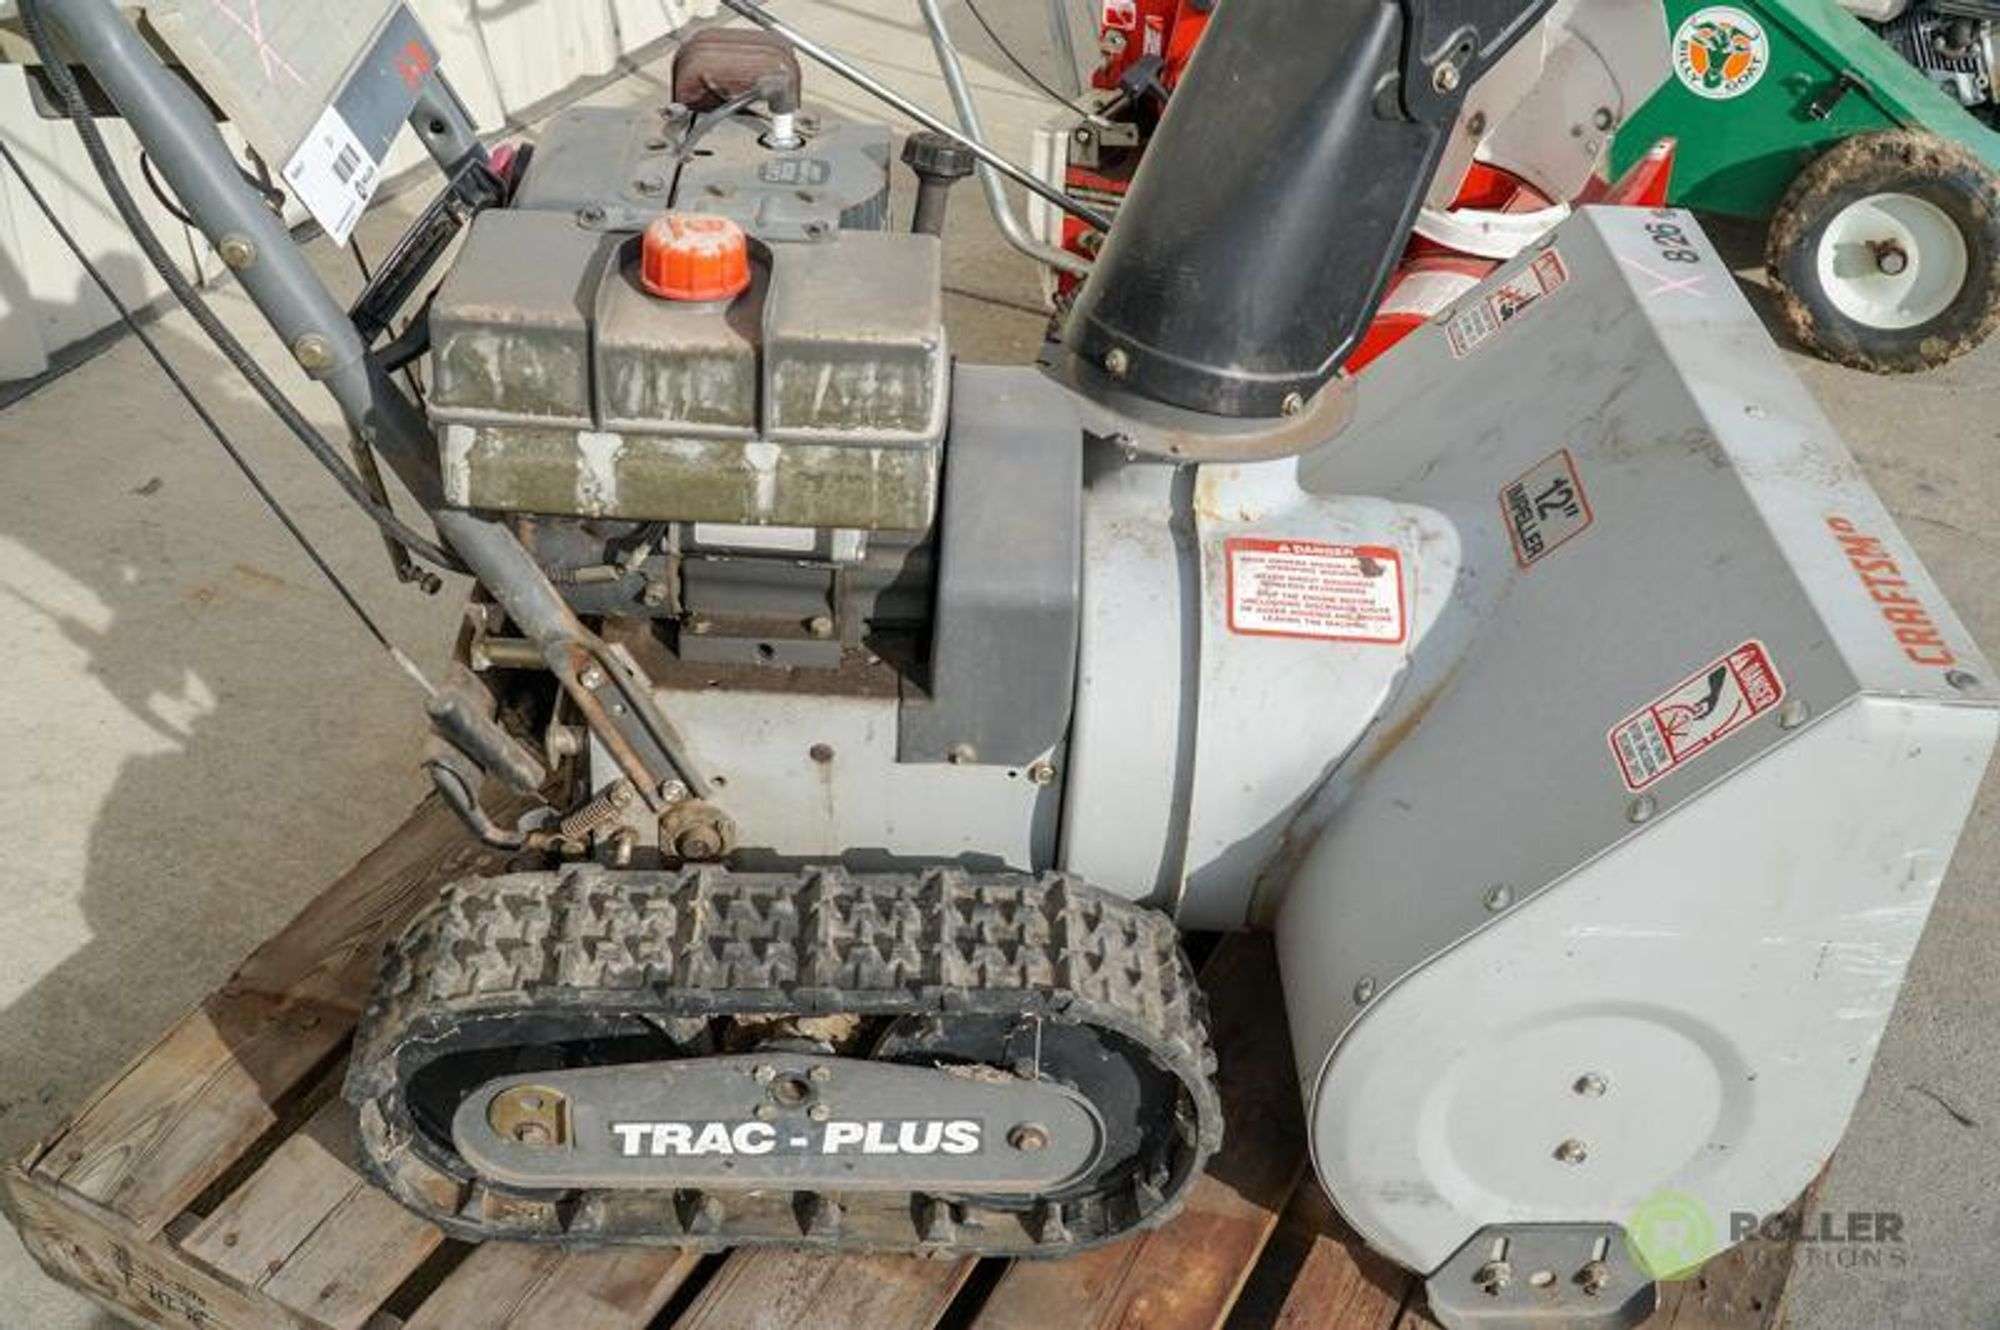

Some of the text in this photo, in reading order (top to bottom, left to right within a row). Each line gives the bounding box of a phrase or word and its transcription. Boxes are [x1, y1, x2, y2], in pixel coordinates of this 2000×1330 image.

[1825, 516, 1956, 666] CRAFTSM
[613, 1121, 776, 1156] TRAC
[822, 1120, 981, 1154] PLUS
